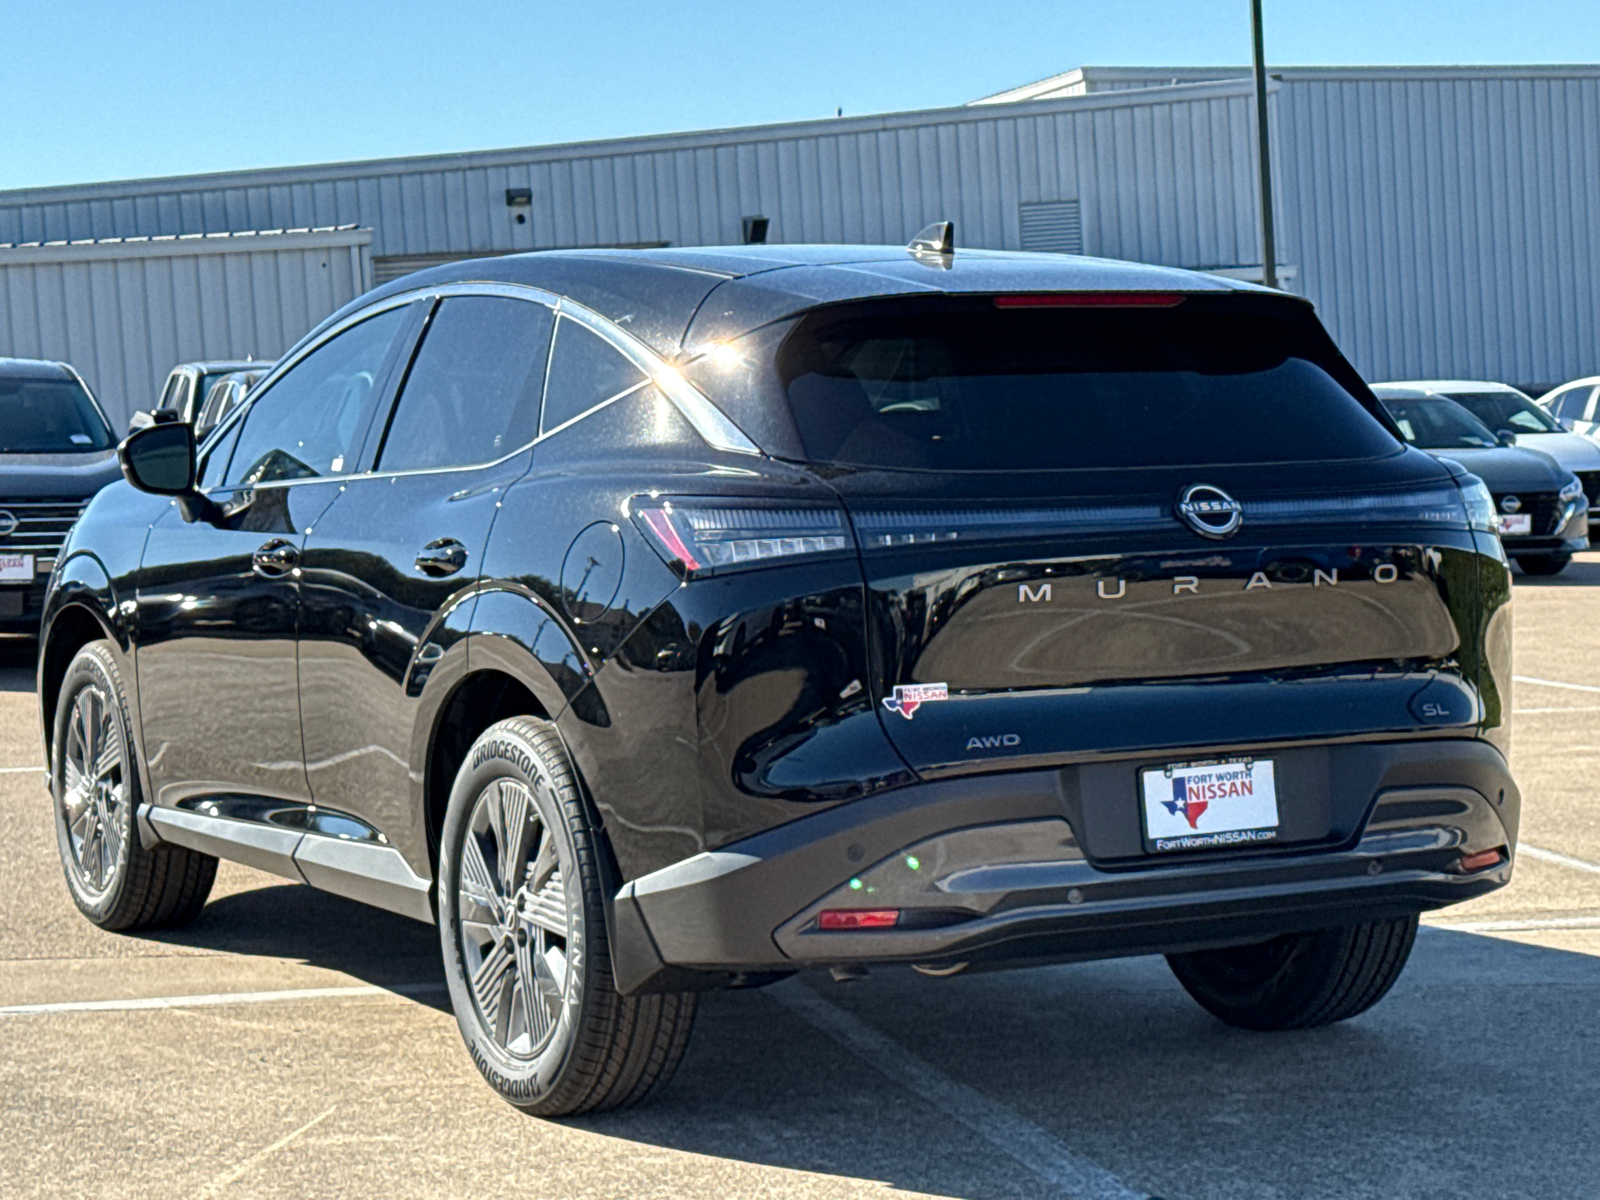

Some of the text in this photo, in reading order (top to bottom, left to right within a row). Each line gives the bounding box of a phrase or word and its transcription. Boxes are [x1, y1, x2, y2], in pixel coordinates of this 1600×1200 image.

[1181, 502, 1241, 512] NISSAN
[1018, 563, 1398, 602] MURANO
[904, 690, 947, 700] NISSAN
[1422, 703, 1450, 717] SL
[966, 734, 1021, 751] AWD
[472, 740, 546, 793] BRIDGESTONE
[1187, 770, 1252, 785] FORT WORTH
[1188, 780, 1253, 800] NISSAN
[468, 1038, 541, 1098] BRIDGESTONE
